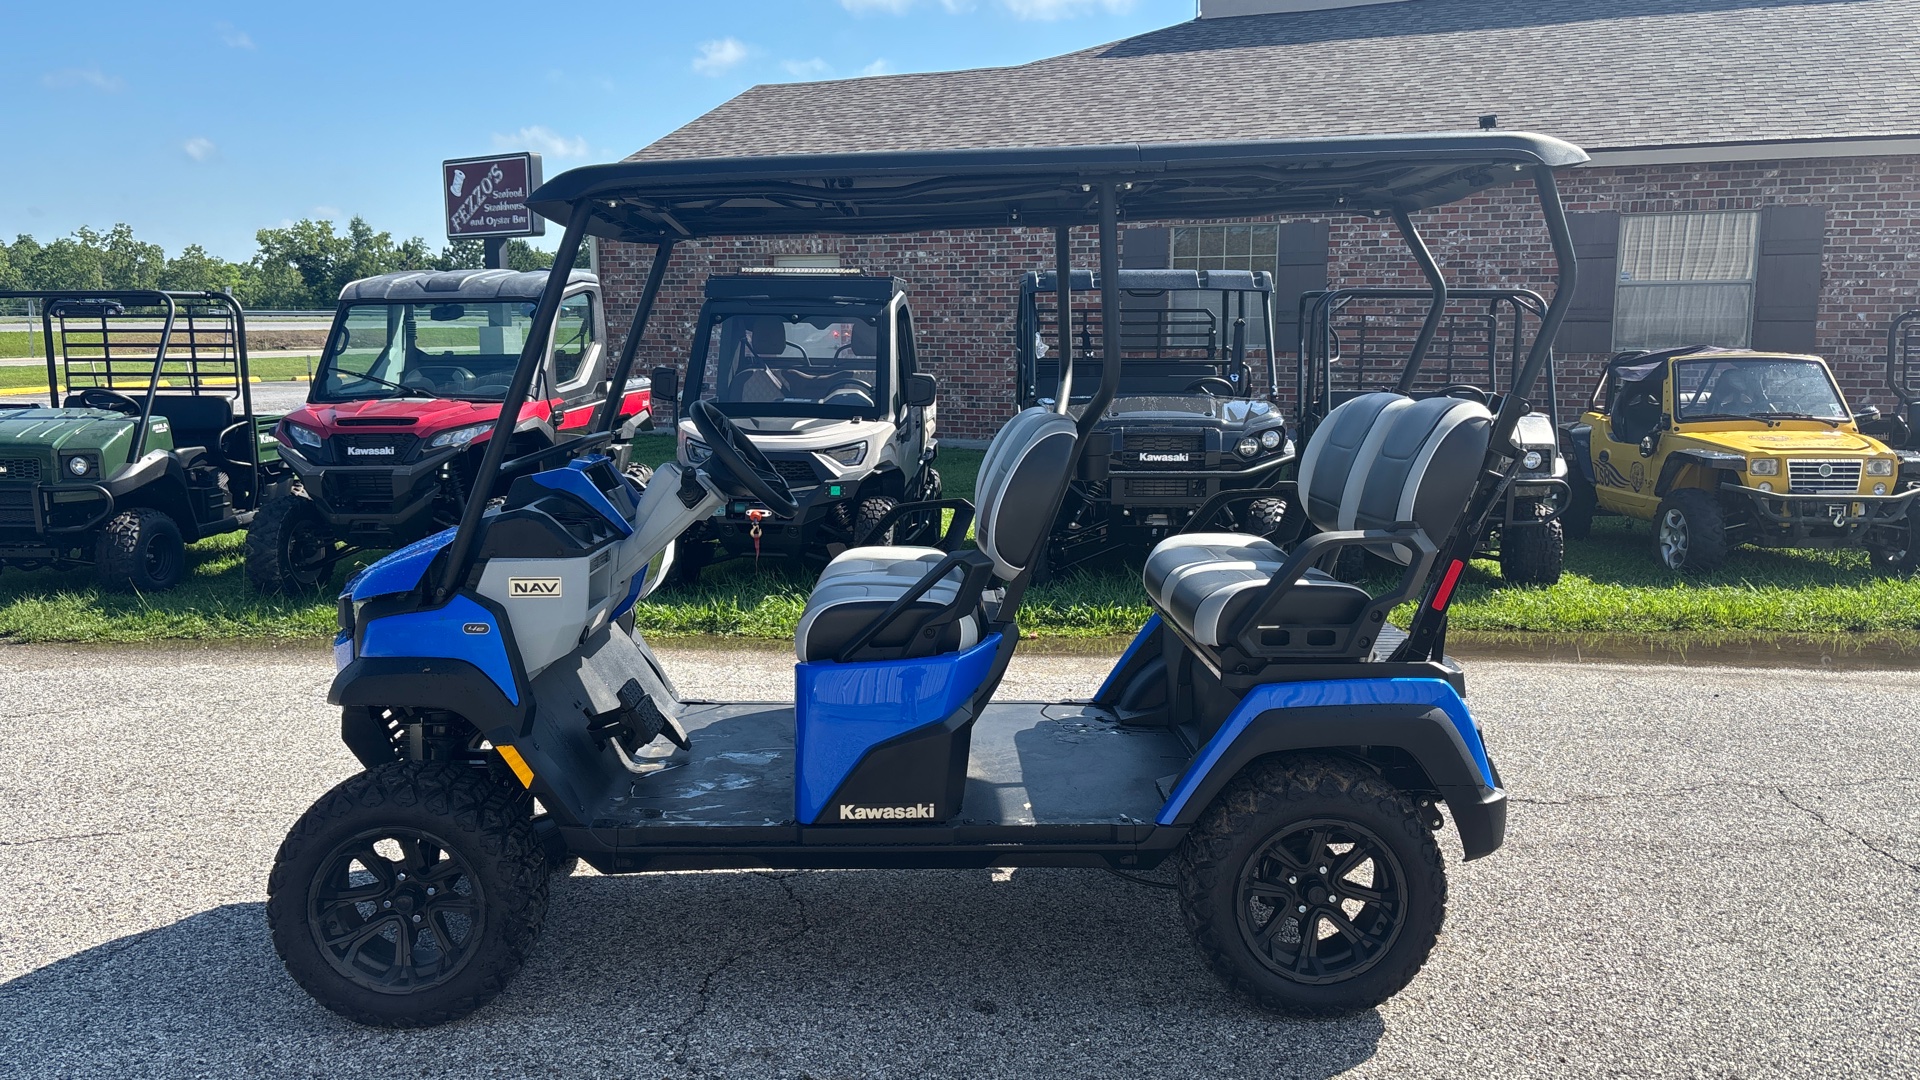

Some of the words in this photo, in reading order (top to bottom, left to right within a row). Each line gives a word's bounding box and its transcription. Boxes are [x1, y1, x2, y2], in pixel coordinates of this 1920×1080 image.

[451, 163, 504, 233] FEZZO'S
[470, 216, 484, 226] and
[486, 216, 511, 227] Oyster
[512, 214, 527, 223] Bar
[347, 446, 395, 455] Kawasaki
[1139, 452, 1189, 462] Kawasaki
[514, 583, 558, 593] NAV
[839, 803, 935, 820] Kawasaki
